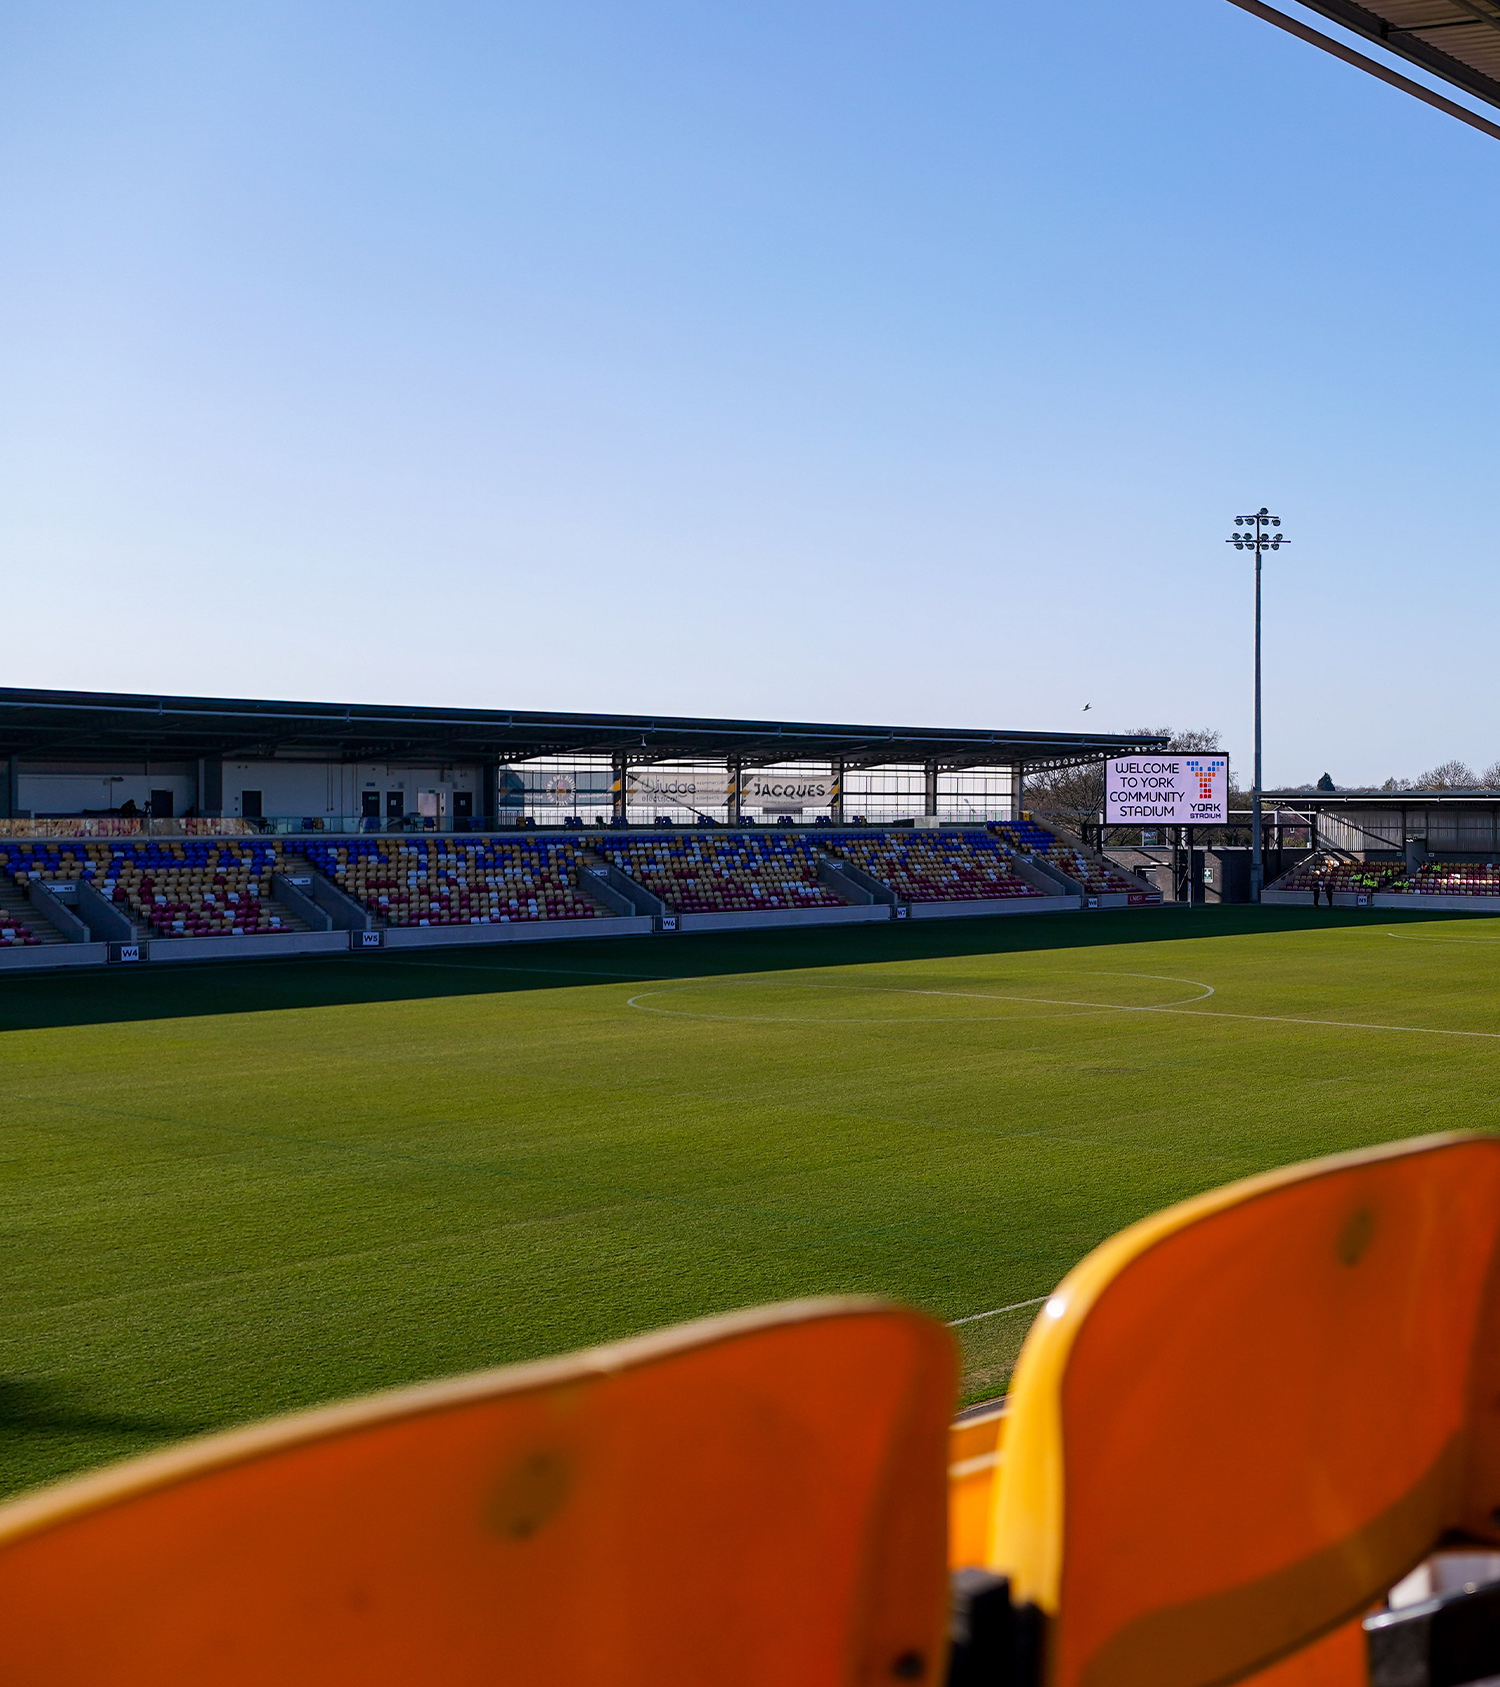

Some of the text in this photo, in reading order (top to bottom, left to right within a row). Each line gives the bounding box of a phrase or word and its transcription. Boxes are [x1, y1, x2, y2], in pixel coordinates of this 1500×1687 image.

[1115, 762, 1179, 774] WELCOME
[1120, 777, 1174, 788] TO YORK
[654, 779, 697, 798] judge
[754, 783, 826, 799] JACQUES
[1109, 791, 1185, 802] COMMUNITY
[1120, 806, 1175, 817] STADIUM
[1189, 803, 1221, 812] YORK
